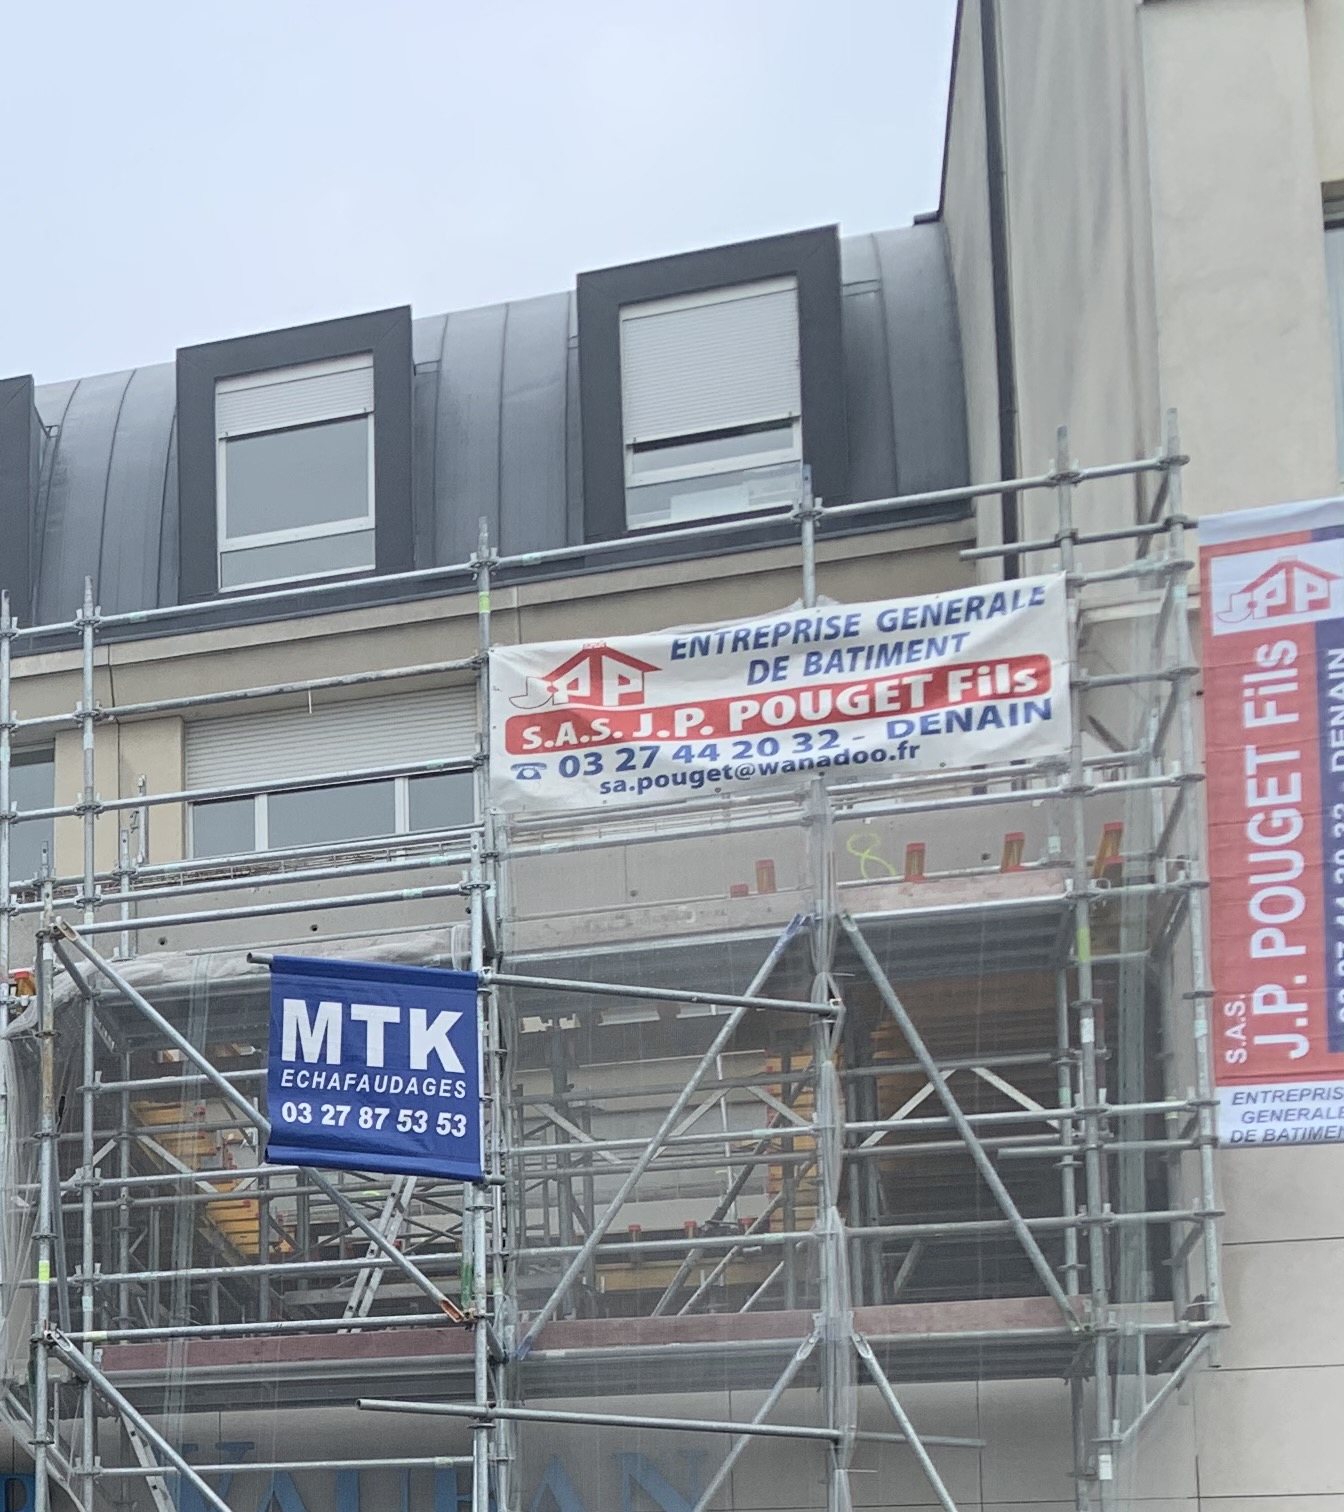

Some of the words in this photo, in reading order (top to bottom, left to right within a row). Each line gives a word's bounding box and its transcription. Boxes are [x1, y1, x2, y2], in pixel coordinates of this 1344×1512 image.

[670, 613, 862, 661] ENTREPRISE
[876, 586, 1047, 632] GENERALE
[747, 656, 789, 686] DE
[803, 631, 971, 677] BATIMENT
[522, 716, 623, 750] S.A.S.
[632, 706, 713, 740] J.P.
[727, 675, 932, 732] POUGET
[946, 663, 1038, 702] Fils
[1243, 639, 1299, 729] Fils
[559, 753, 603, 779] 03
[615, 747, 661, 773] 27
[671, 739, 721, 764] 44
[731, 736, 780, 761] 20
[791, 728, 840, 754] 32
[886, 697, 1053, 741] DENAIN
[599, 740, 921, 796] sa.pouget@wanadoo.fr
[1245, 745, 1308, 959] POUGET
[281, 998, 466, 1074] MTK
[1224, 994, 1248, 1064] S.A.S.
[1252, 974, 1310, 1060] J.P.
[280, 1068, 467, 1099] ECHAFAUDAGES
[281, 1101, 313, 1124] 03
[321, 1104, 351, 1127] 27
[359, 1107, 390, 1130] 87
[396, 1110, 429, 1134] 53
[436, 1112, 467, 1138] 53
[1230, 1129, 1257, 1143] DE
